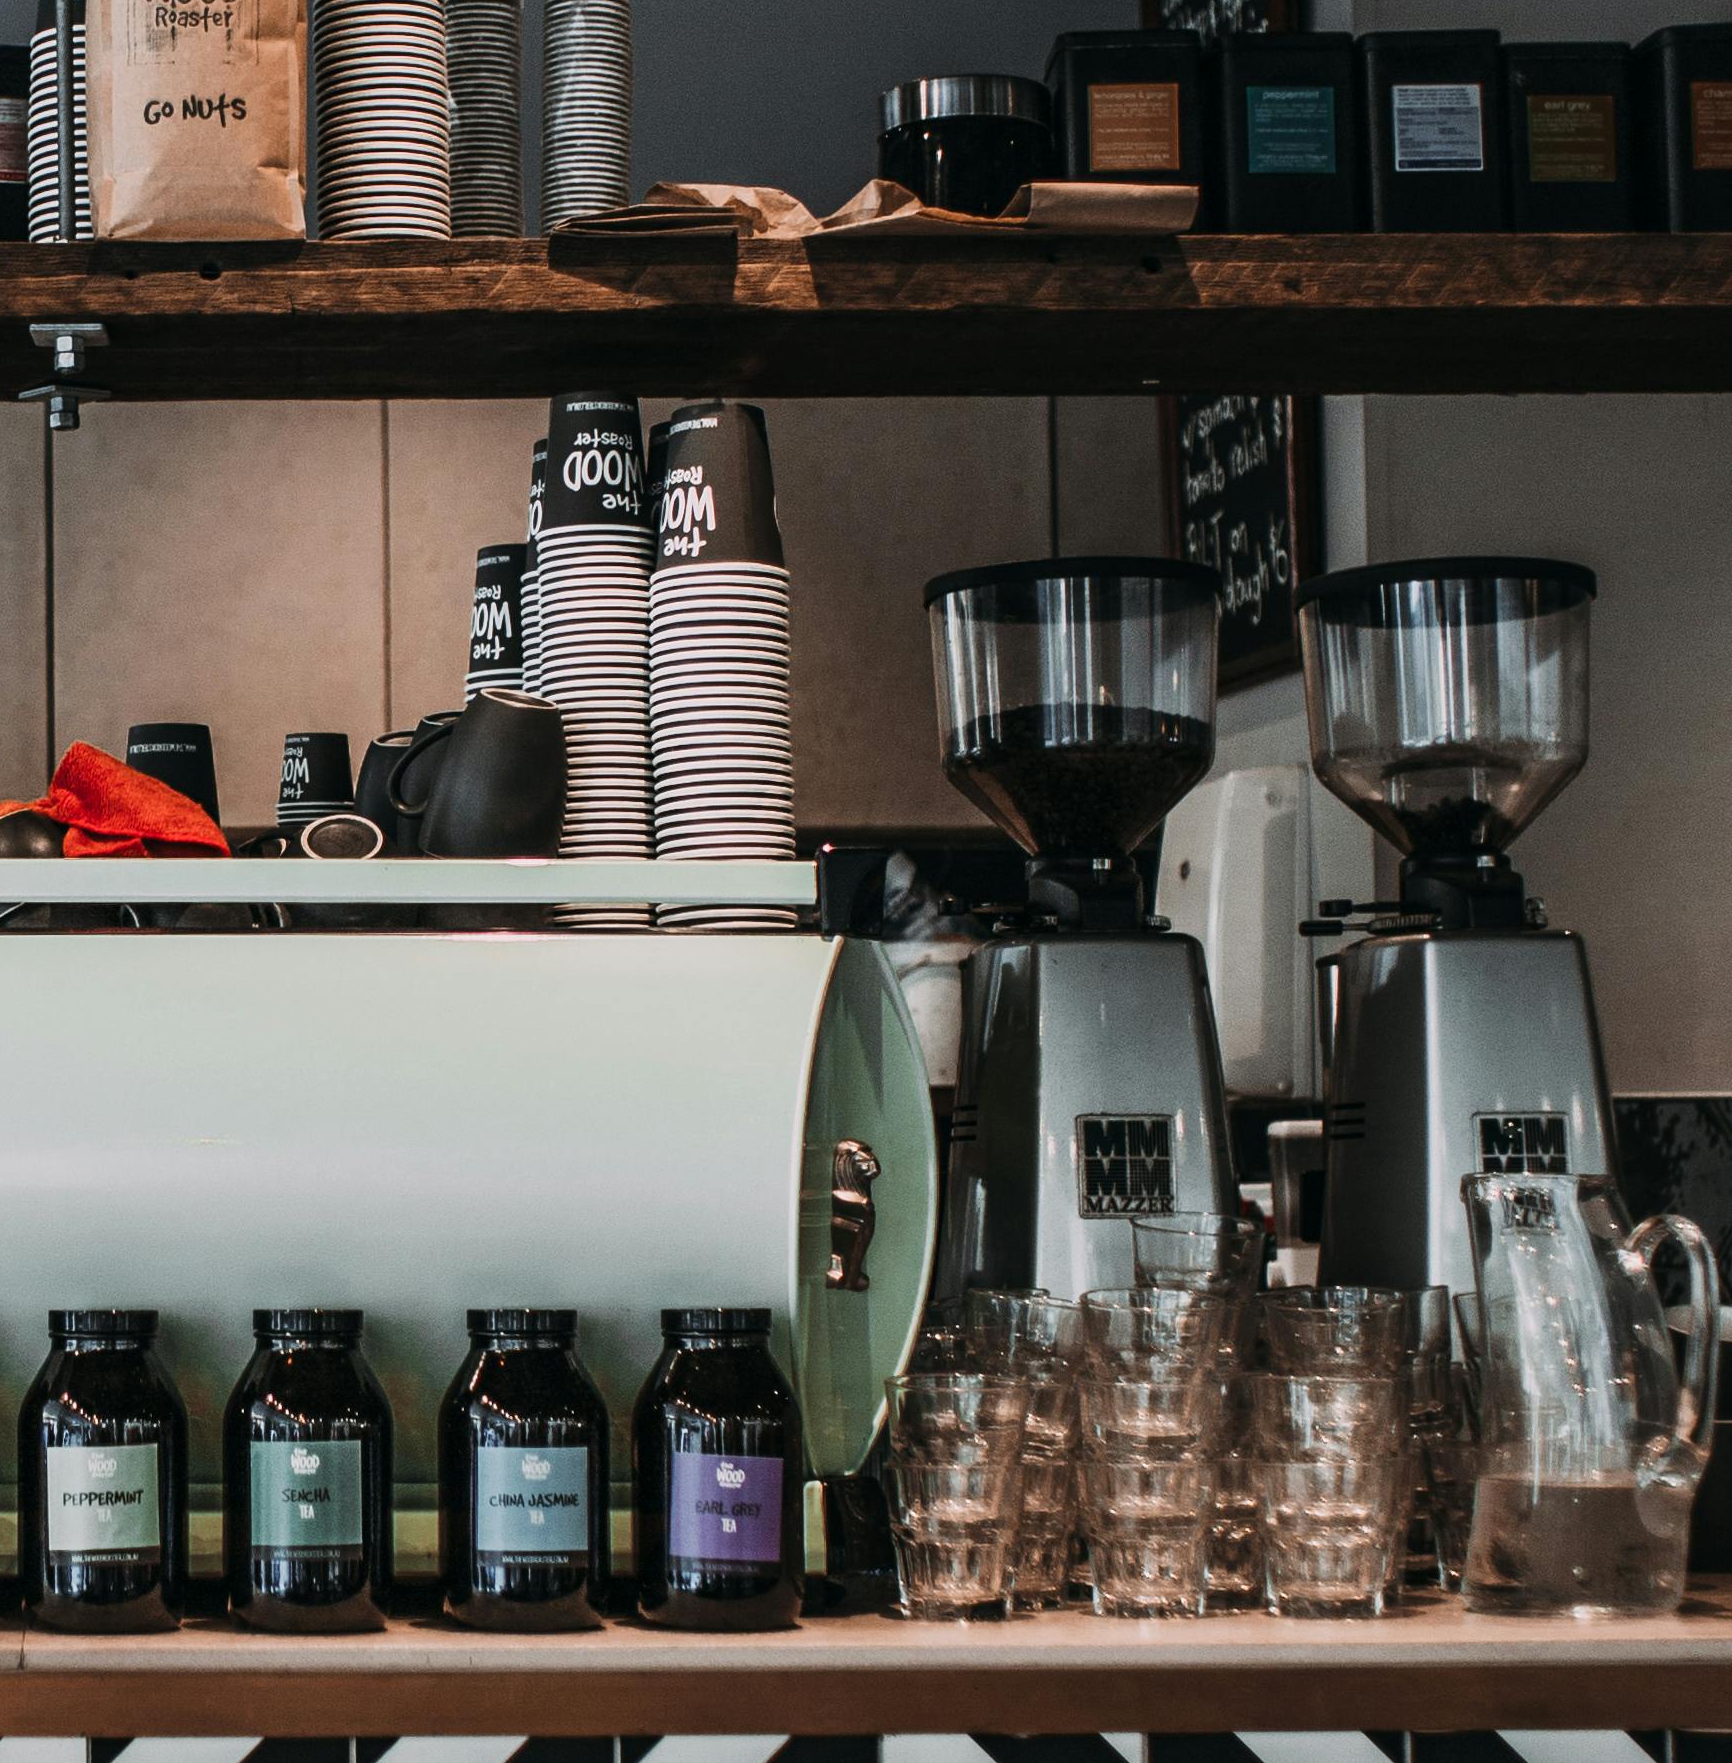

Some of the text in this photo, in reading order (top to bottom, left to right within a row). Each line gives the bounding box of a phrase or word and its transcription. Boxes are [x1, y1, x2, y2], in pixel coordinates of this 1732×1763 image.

[156, 5, 233, 32] Roaster
[573, 428, 633, 451] Roaster
[563, 449, 644, 494] WOOD
[602, 490, 642, 515] the
[663, 527, 707, 557] the
[473, 635, 505, 660] the
[1087, 1196, 1174, 1213] MAZZER
[88, 1459, 117, 1473] WOOD
[290, 1454, 320, 1470] WOOD
[716, 1467, 745, 1484] WOOD
[63, 1489, 144, 1507] PEPPERMINT
[282, 1488, 331, 1503] SENCHA
[489, 1493, 580, 1508] CHINA JASMINE
[97, 1509, 113, 1523] TEA
[299, 1504, 315, 1519] TEA
[528, 1509, 545, 1525] TEA
[695, 1500, 763, 1518] EARL GREY
[721, 1518, 736, 1533] TEA
